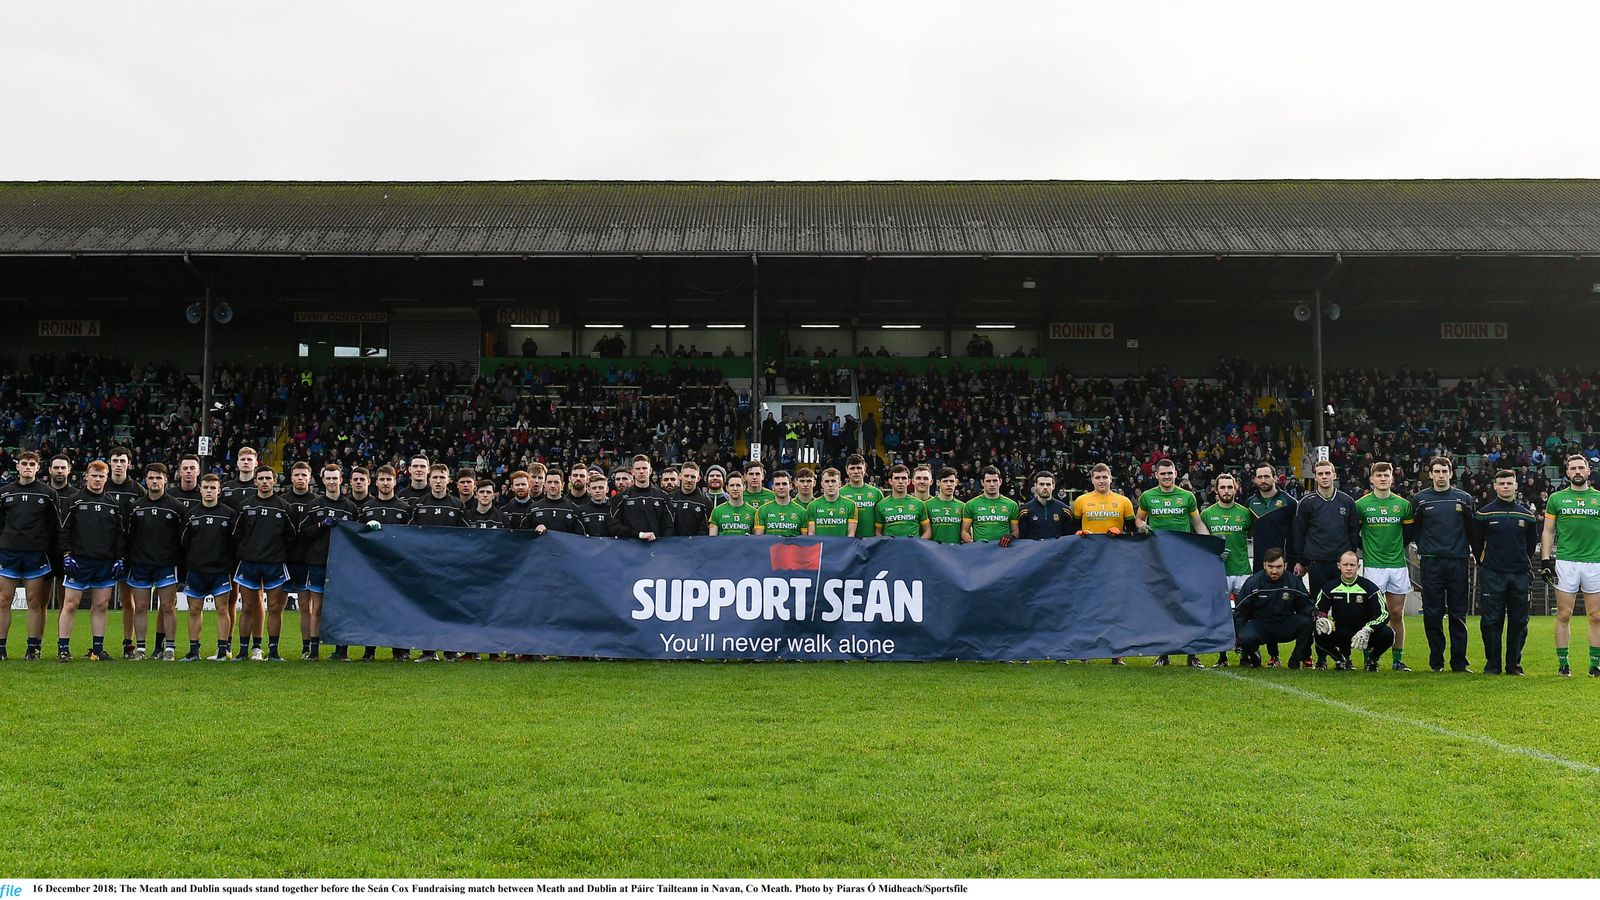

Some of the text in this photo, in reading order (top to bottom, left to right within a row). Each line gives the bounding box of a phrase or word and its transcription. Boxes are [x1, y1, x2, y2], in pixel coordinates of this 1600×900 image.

[295, 312, 386, 322] EVENT CONTROLLER
[501, 310, 558, 322] ROINN B
[41, 322, 96, 336] ROINN A
[1052, 324, 1110, 338] ROINN C
[1444, 324, 1505, 338] ROINN D
[631, 570, 923, 622] SUPPORT SEÁN
[723, 636, 781, 652] never
[787, 634, 833, 653] walk
[838, 635, 895, 654] alone
